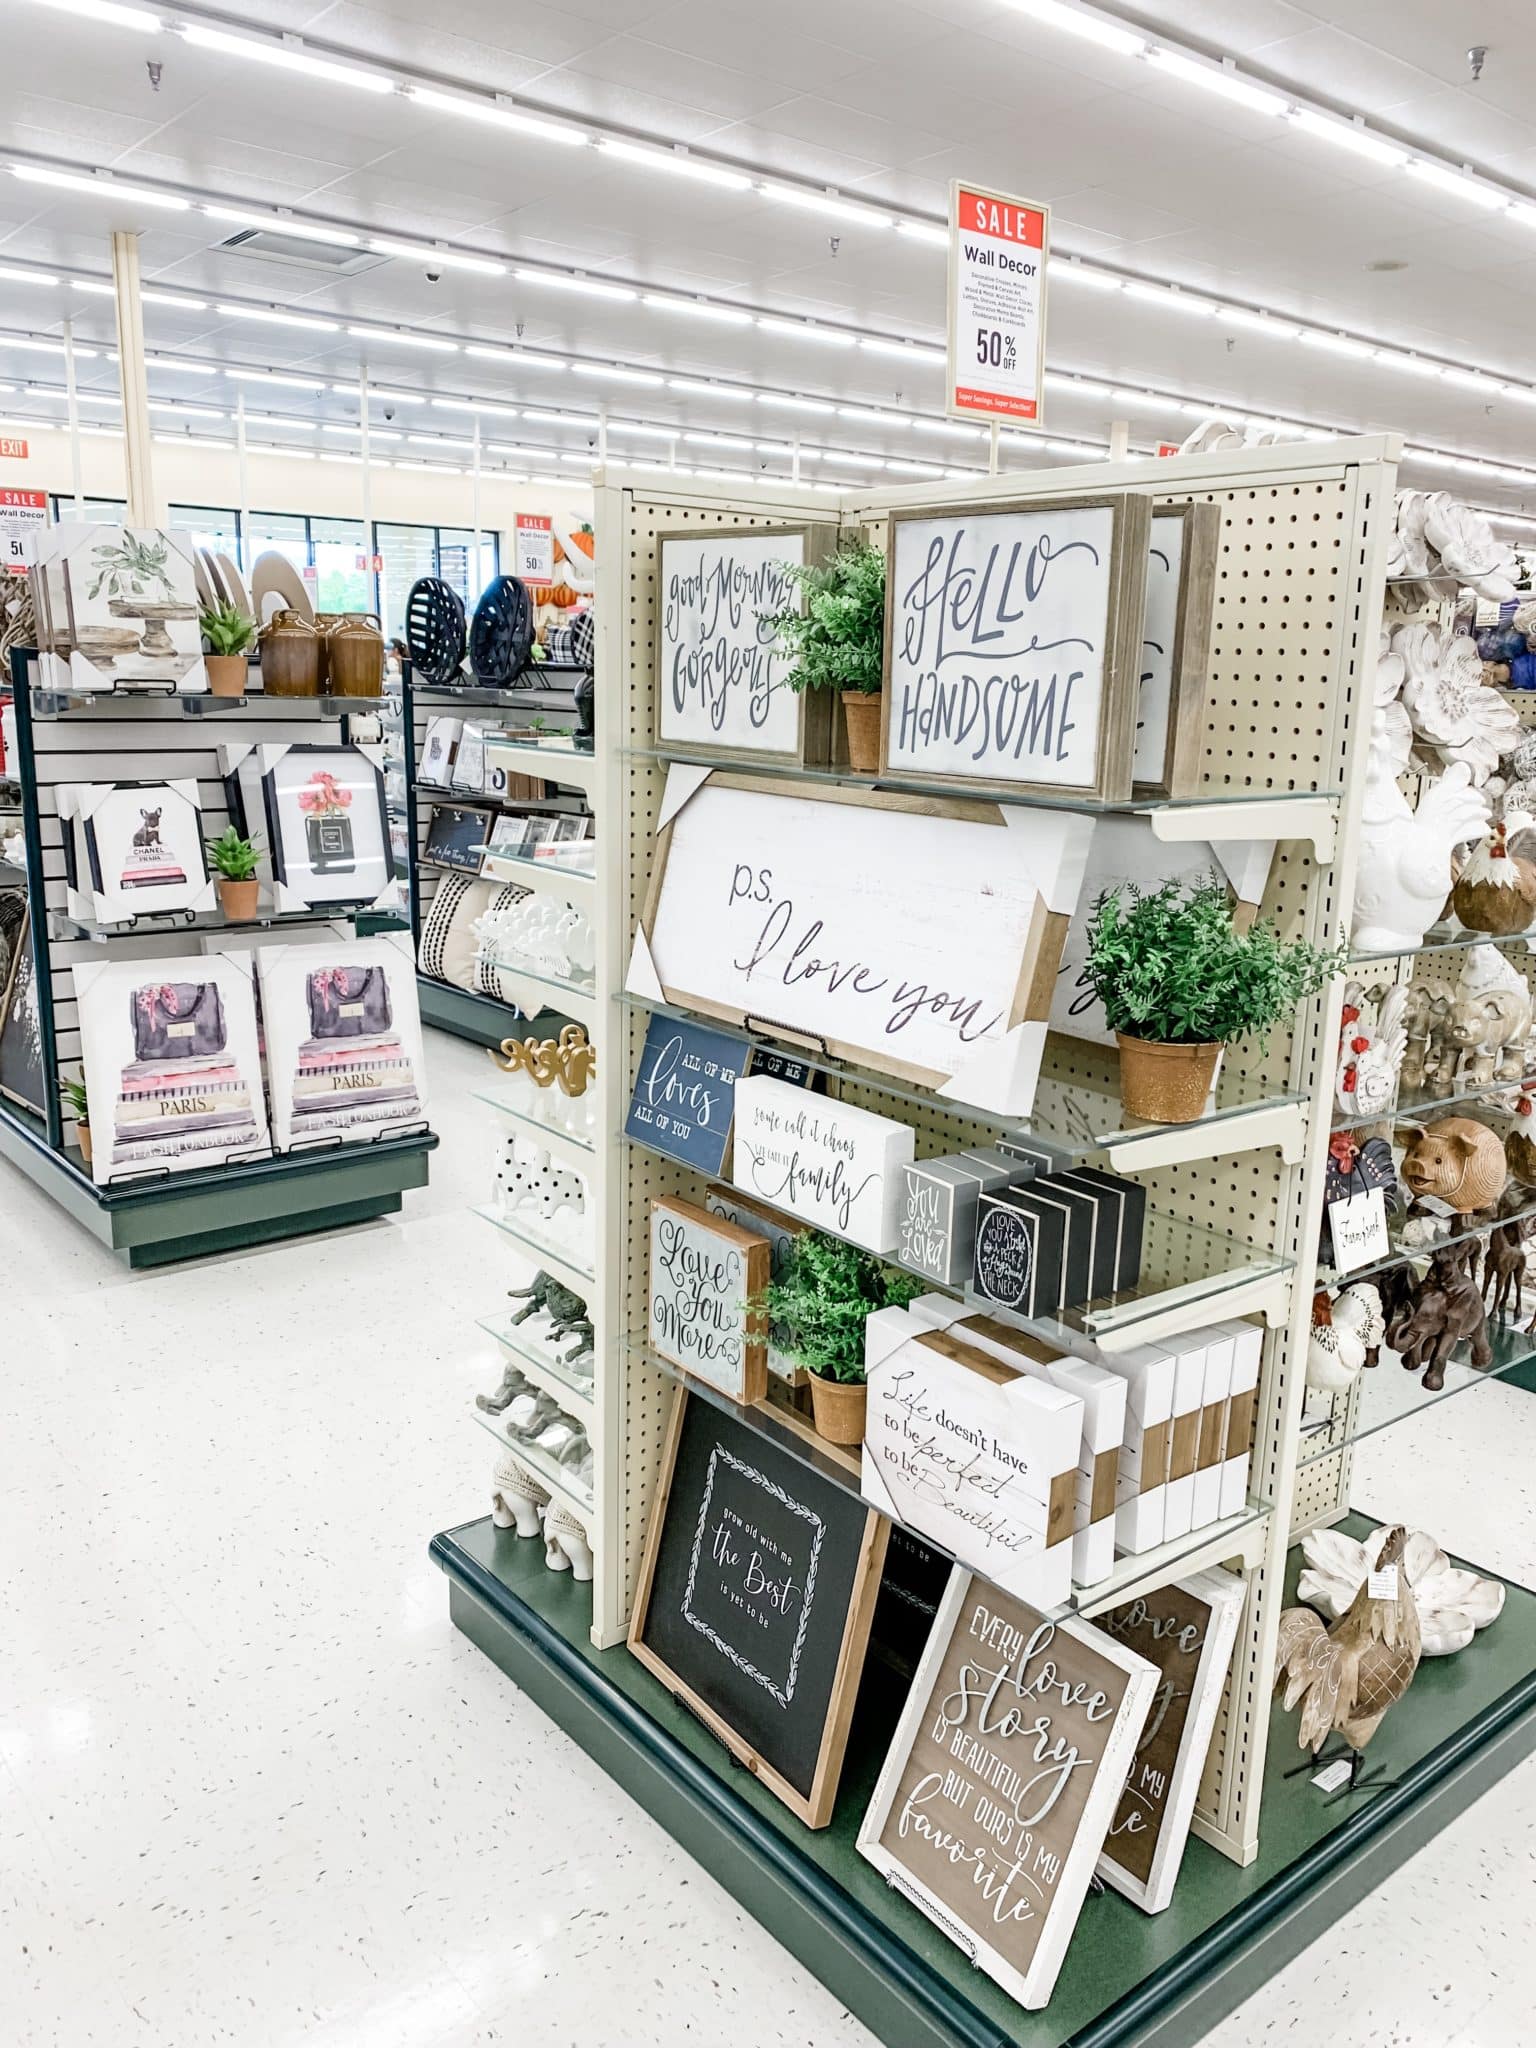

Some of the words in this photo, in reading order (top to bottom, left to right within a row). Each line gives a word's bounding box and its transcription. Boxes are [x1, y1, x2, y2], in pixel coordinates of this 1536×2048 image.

[976, 199, 1026, 240] SALE
[964, 244, 995, 267] Wall
[1000, 254, 1037, 277] Decor
[1003, 357, 1016, 372] OFF
[0, 440, 24, 456] EXIT
[5, 491, 37, 506] SALE
[20, 510, 45, 520] Decor
[523, 517, 545, 530] SALE
[133, 848, 164, 856] CHANEL
[783, 921, 888, 992] love
[885, 982, 1005, 1042] you
[333, 1072, 374, 1090] PARIS
[642, 1035, 720, 1126] loves
[682, 1053, 701, 1071] ALL
[704, 1061, 718, 1078] OF
[720, 1067, 735, 1085] ME
[768, 1056, 782, 1073] OF
[785, 1062, 802, 1080] ME
[160, 1097, 207, 1116] PARIS
[634, 1105, 653, 1124] ALL
[656, 1113, 669, 1129] OF
[671, 1120, 691, 1140] YOU
[753, 1107, 780, 1131] some
[785, 1110, 806, 1139] call
[810, 1120, 820, 1142] it
[823, 1122, 854, 1160] chaos
[987, 1228, 1003, 1243] YOU
[996, 1215, 1016, 1232] LOVE
[659, 1219, 740, 1293] Love
[983, 1271, 995, 1291] THE
[997, 1279, 1019, 1297] NECK
[676, 1278, 738, 1331] You
[654, 1295, 740, 1366] More
[882, 1371, 931, 1421] Life
[935, 1409, 986, 1451] doesn't
[993, 1439, 1028, 1474] have
[885, 1413, 898, 1430] to
[904, 1420, 919, 1442] be
[884, 1446, 898, 1464] to
[902, 1451, 918, 1475] be
[911, 1436, 1014, 1498] perfect
[723, 1508, 742, 1527] grow
[745, 1524, 758, 1539] old
[760, 1535, 778, 1555] with
[780, 1551, 792, 1566] me
[711, 1522, 740, 1566] the
[744, 1550, 801, 1615] Best
[720, 1581, 728, 1594] is
[730, 1591, 744, 1608] yet
[747, 1603, 756, 1617] to
[758, 1612, 769, 1628] be
[968, 1605, 1025, 1662] EVERY
[1015, 1621, 1113, 1721] love
[931, 1713, 948, 1744] IS
[948, 1728, 1022, 1804] BEAUTIFUL
[1140, 1764, 1165, 1799] MY
[941, 1768, 974, 1809] BUT
[973, 1795, 1015, 1846] OURS
[1014, 1829, 1033, 1859] IS
[1032, 1845, 1060, 1884] MY
[899, 1772, 1046, 1924] favorite
